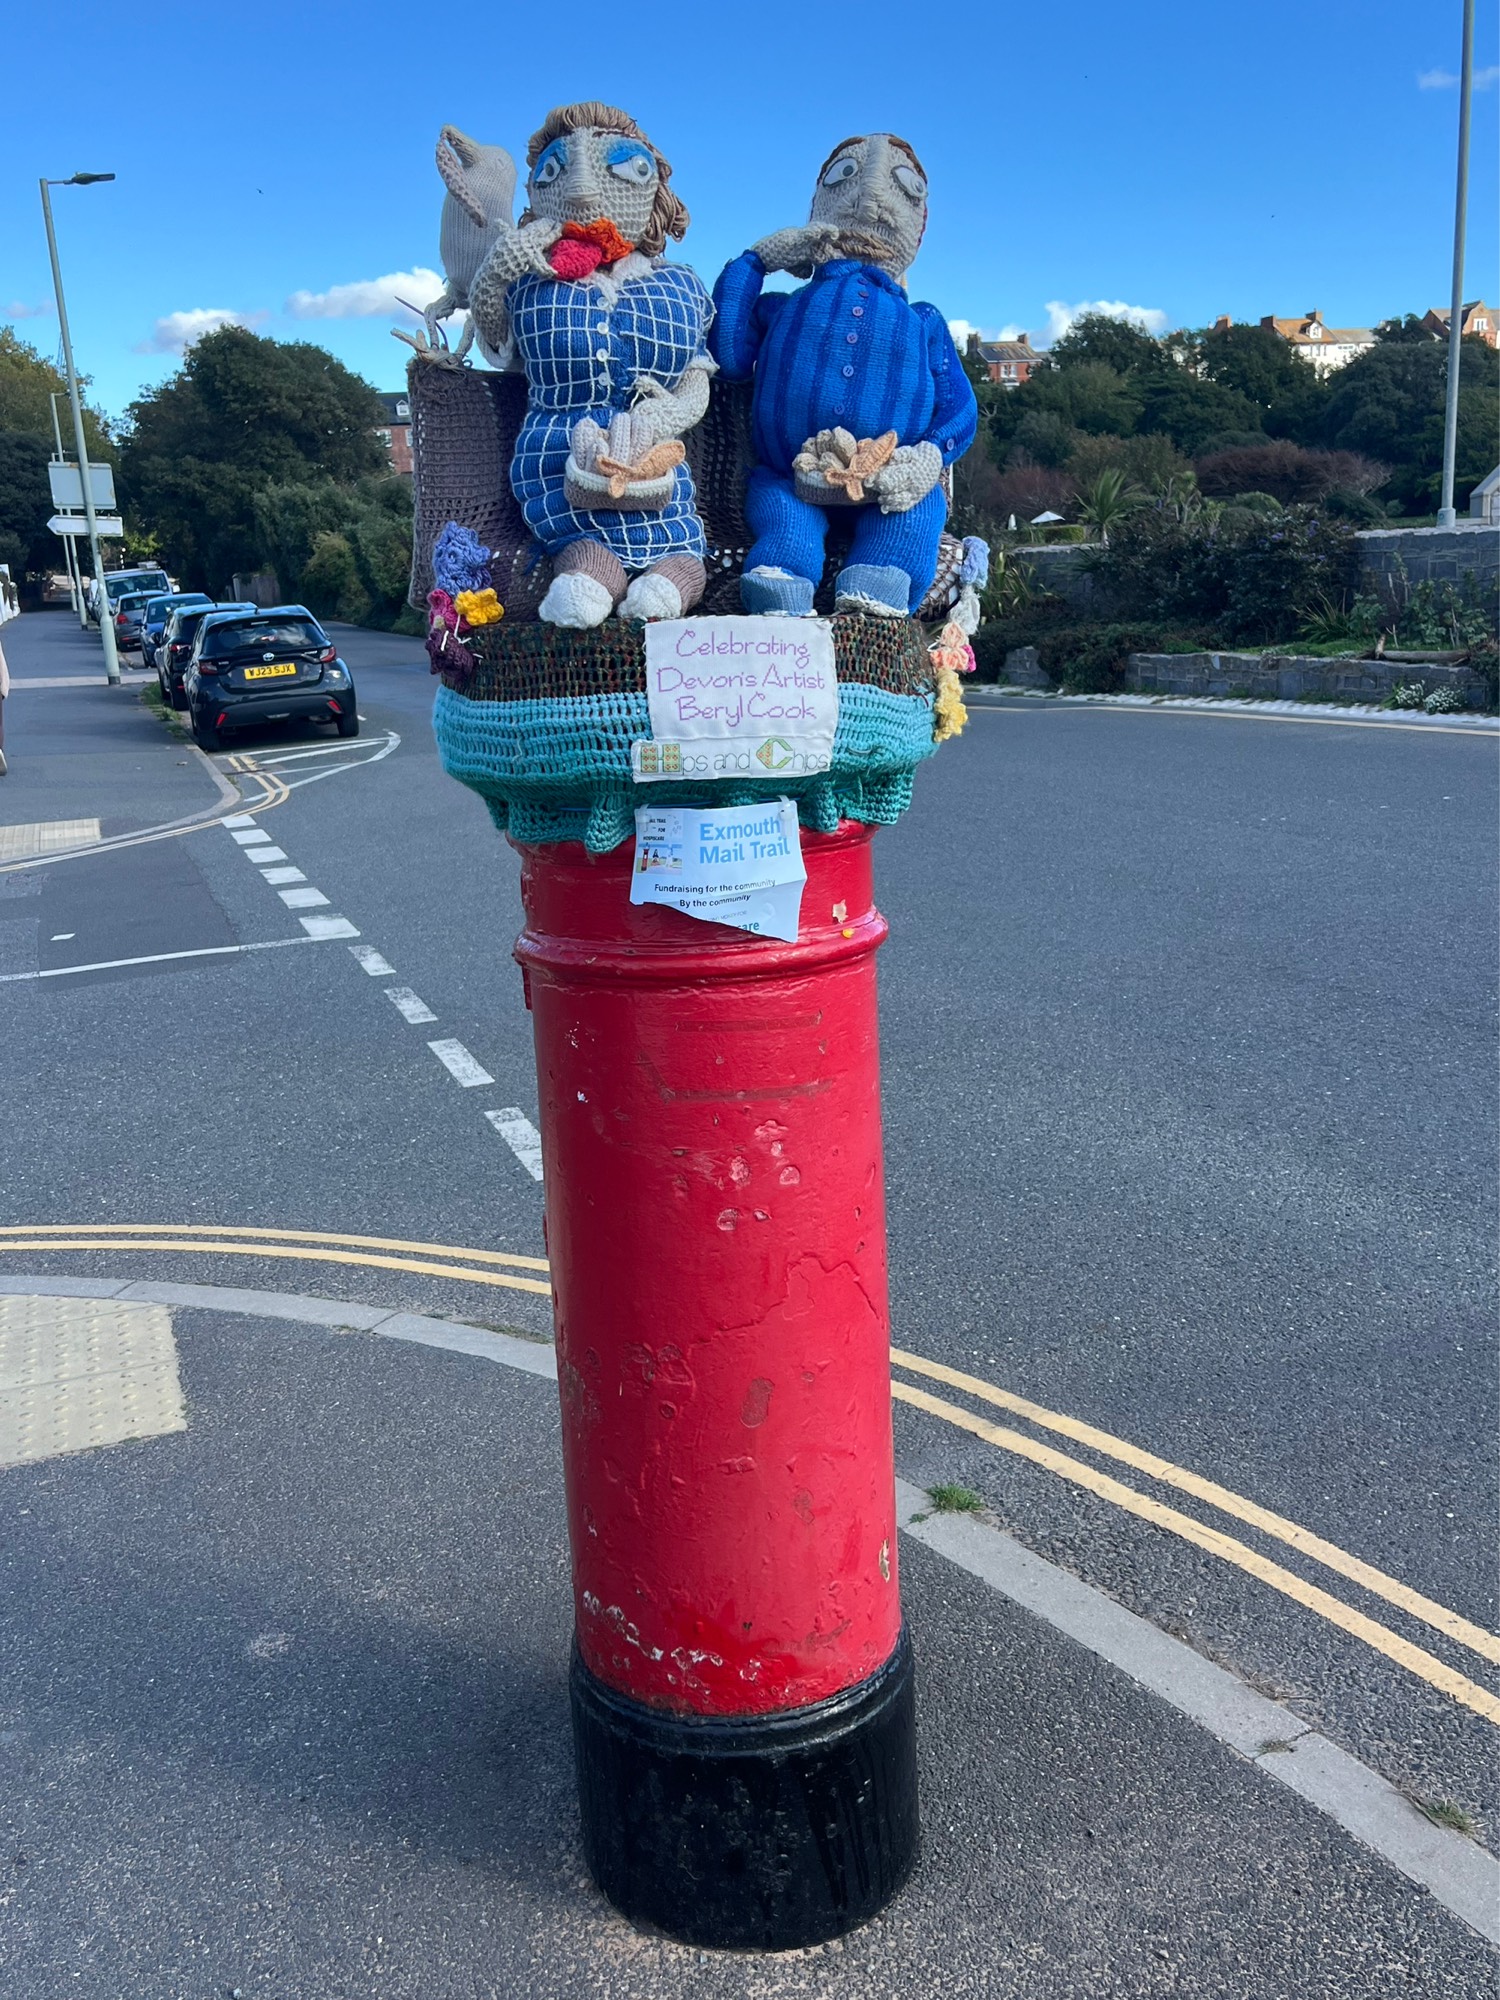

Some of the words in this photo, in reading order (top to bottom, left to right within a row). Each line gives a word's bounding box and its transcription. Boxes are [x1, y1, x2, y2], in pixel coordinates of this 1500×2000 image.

[676, 629, 811, 669] Celebrating
[249, 667, 272, 676] WJ23
[274, 665, 291, 673] SJX
[762, 663, 825, 689] Artist
[675, 695, 743, 727] Beryl
[747, 692, 817, 719] Cook
[714, 748, 750, 770] and
[756, 738, 829, 773] Chips
[700, 817, 780, 841] Exmouth
[700, 843, 744, 864] Mail
[750, 837, 790, 859] Trail
[655, 884, 703, 894] Fundraising
[706, 885, 717, 893] for
[720, 884, 732, 892] the
[735, 879, 775, 890] community
[680, 900, 691, 908] By
[709, 894, 751, 906] community
